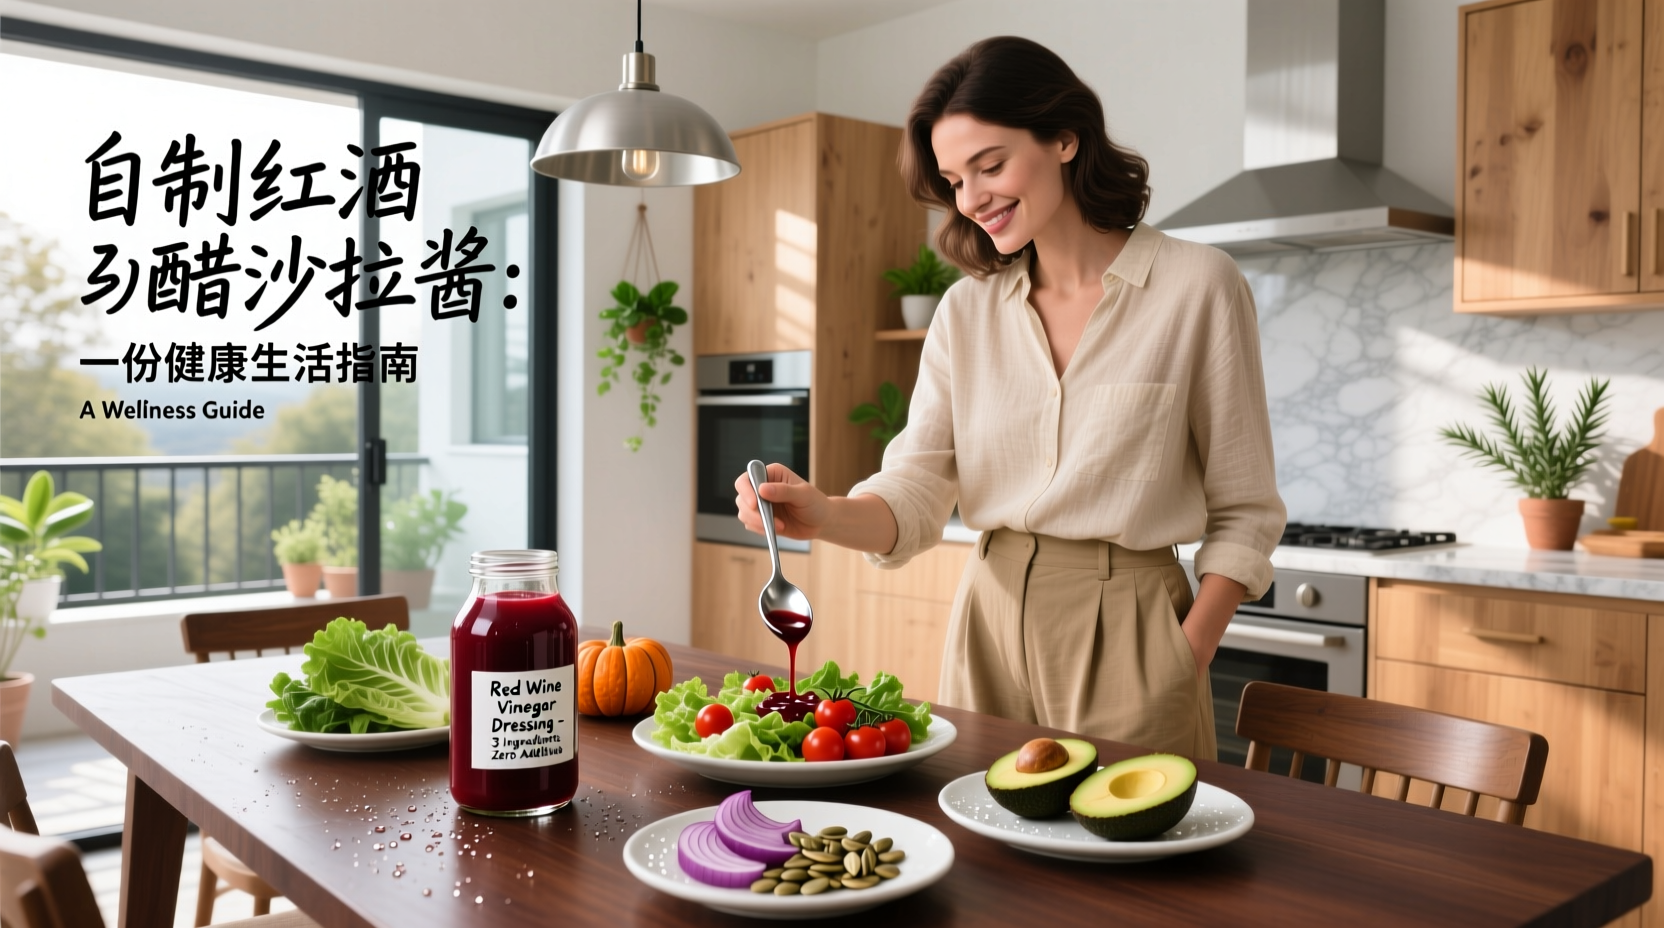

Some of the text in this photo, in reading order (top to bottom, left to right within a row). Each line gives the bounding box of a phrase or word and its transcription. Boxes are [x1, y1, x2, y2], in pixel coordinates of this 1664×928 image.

[490, 679, 562, 697] Red Wine
[497, 700, 557, 719] Vinegar
[491, 717, 554, 734] Dressing
[491, 737, 500, 748] 3
[491, 750, 517, 760] Zero
